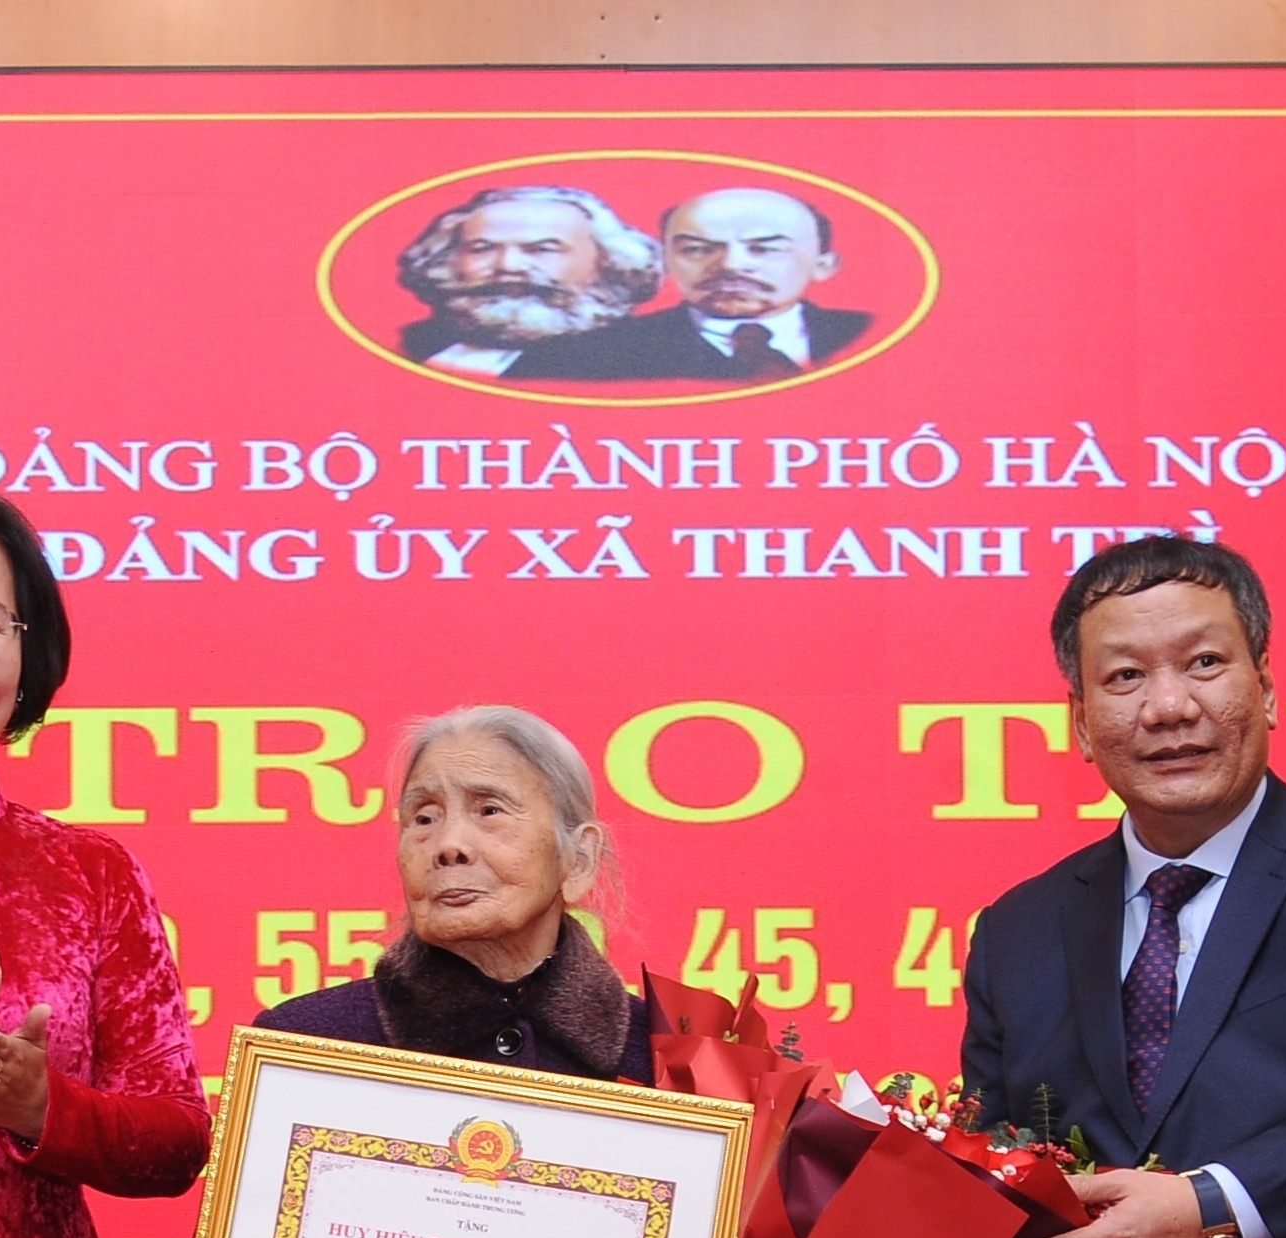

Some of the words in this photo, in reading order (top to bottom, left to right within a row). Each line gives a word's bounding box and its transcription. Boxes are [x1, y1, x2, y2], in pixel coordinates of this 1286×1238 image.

[240, 431, 379, 502] BỘ
[400, 424, 742, 492] THÀNH
[765, 423, 961, 489] PHỐ
[983, 421, 1126, 488] HÀ
[39, 514, 324, 581] ĐẢNG
[348, 514, 489, 580] ỦY
[506, 514, 651, 579] XÃ
[671, 526, 1029, 579] THANH
[6, 700, 805, 826] TRO
[681, 907, 854, 1023] 45,
[457, 1219, 489, 1233] TẶNG
